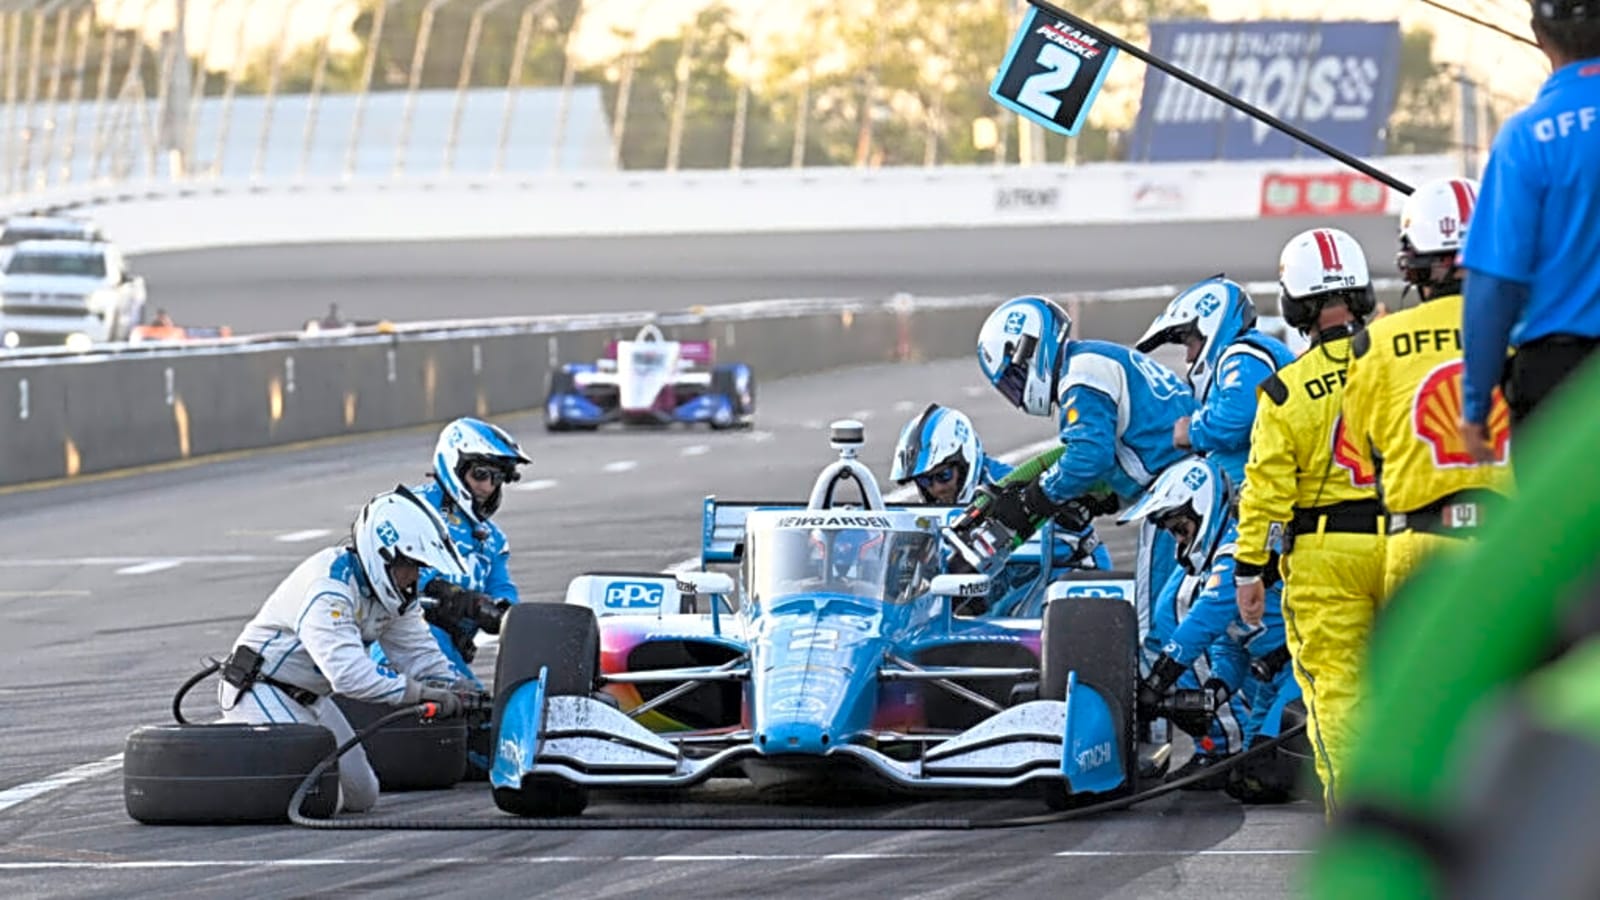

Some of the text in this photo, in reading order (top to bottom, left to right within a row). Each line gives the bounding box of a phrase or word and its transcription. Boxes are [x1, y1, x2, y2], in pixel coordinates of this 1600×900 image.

[1036, 26, 1098, 59] PENSKE
[1054, 21, 1098, 46] TEAM
[1016, 43, 1081, 119] 2
[1534, 107, 1597, 142] OFF
[776, 516, 892, 529] NEWGARDEN
[606, 584, 662, 607] PPG
[788, 629, 839, 651] 2
